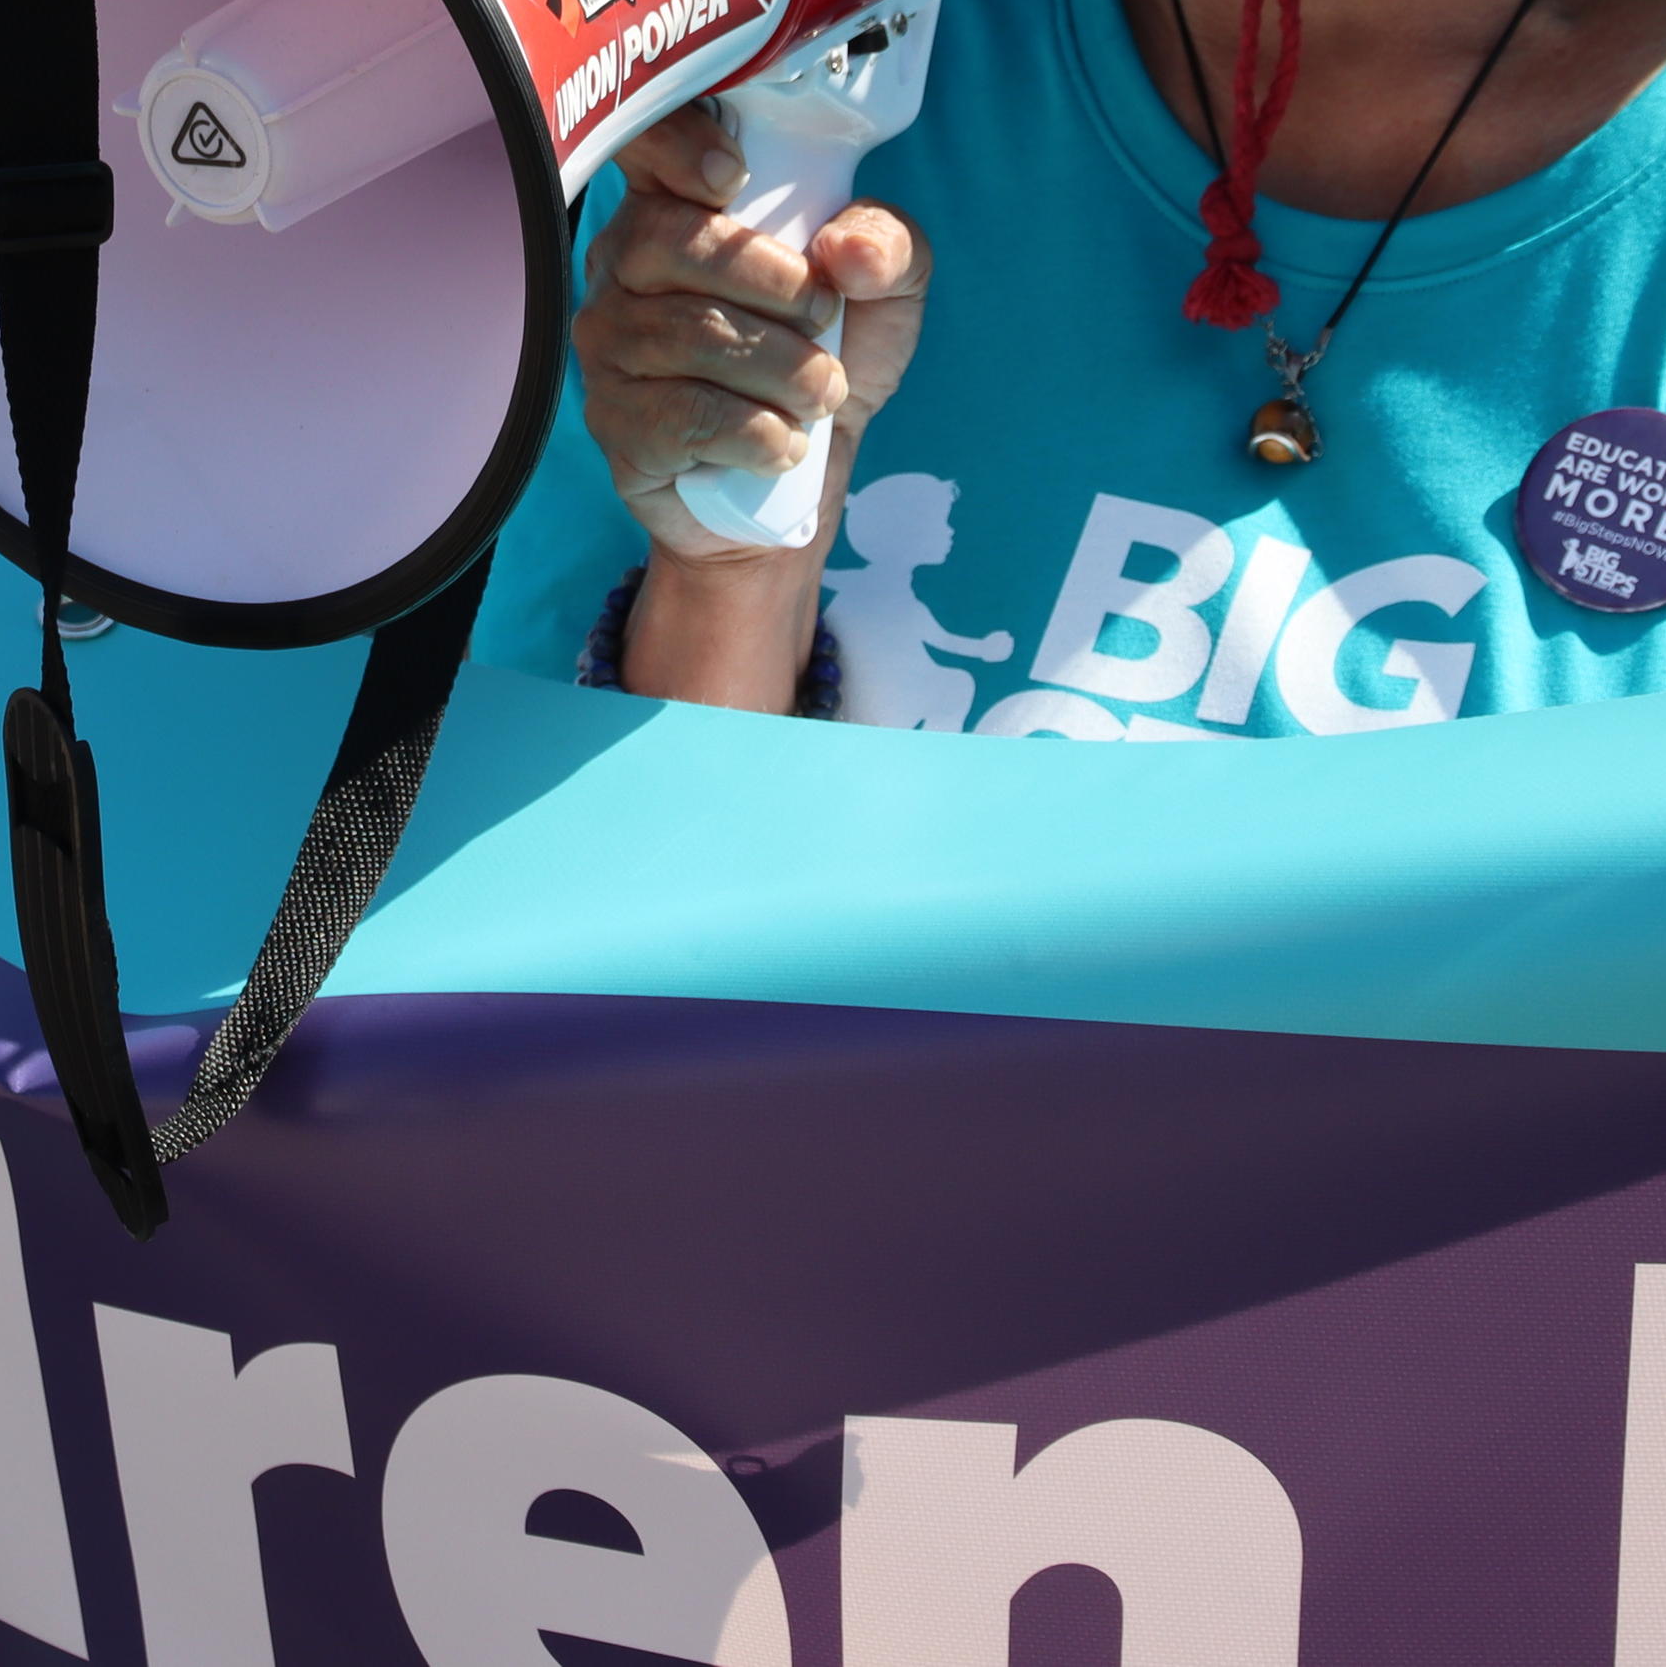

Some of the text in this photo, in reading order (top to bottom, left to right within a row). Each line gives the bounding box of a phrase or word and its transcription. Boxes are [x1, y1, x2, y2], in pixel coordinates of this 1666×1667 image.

[555, 40, 618, 142] UNION
[1555, 454, 1612, 485] ARE
[1585, 545, 1622, 570] BIG
[1577, 562, 1639, 594] STEPS
[1029, 493, 1489, 736] BIG
